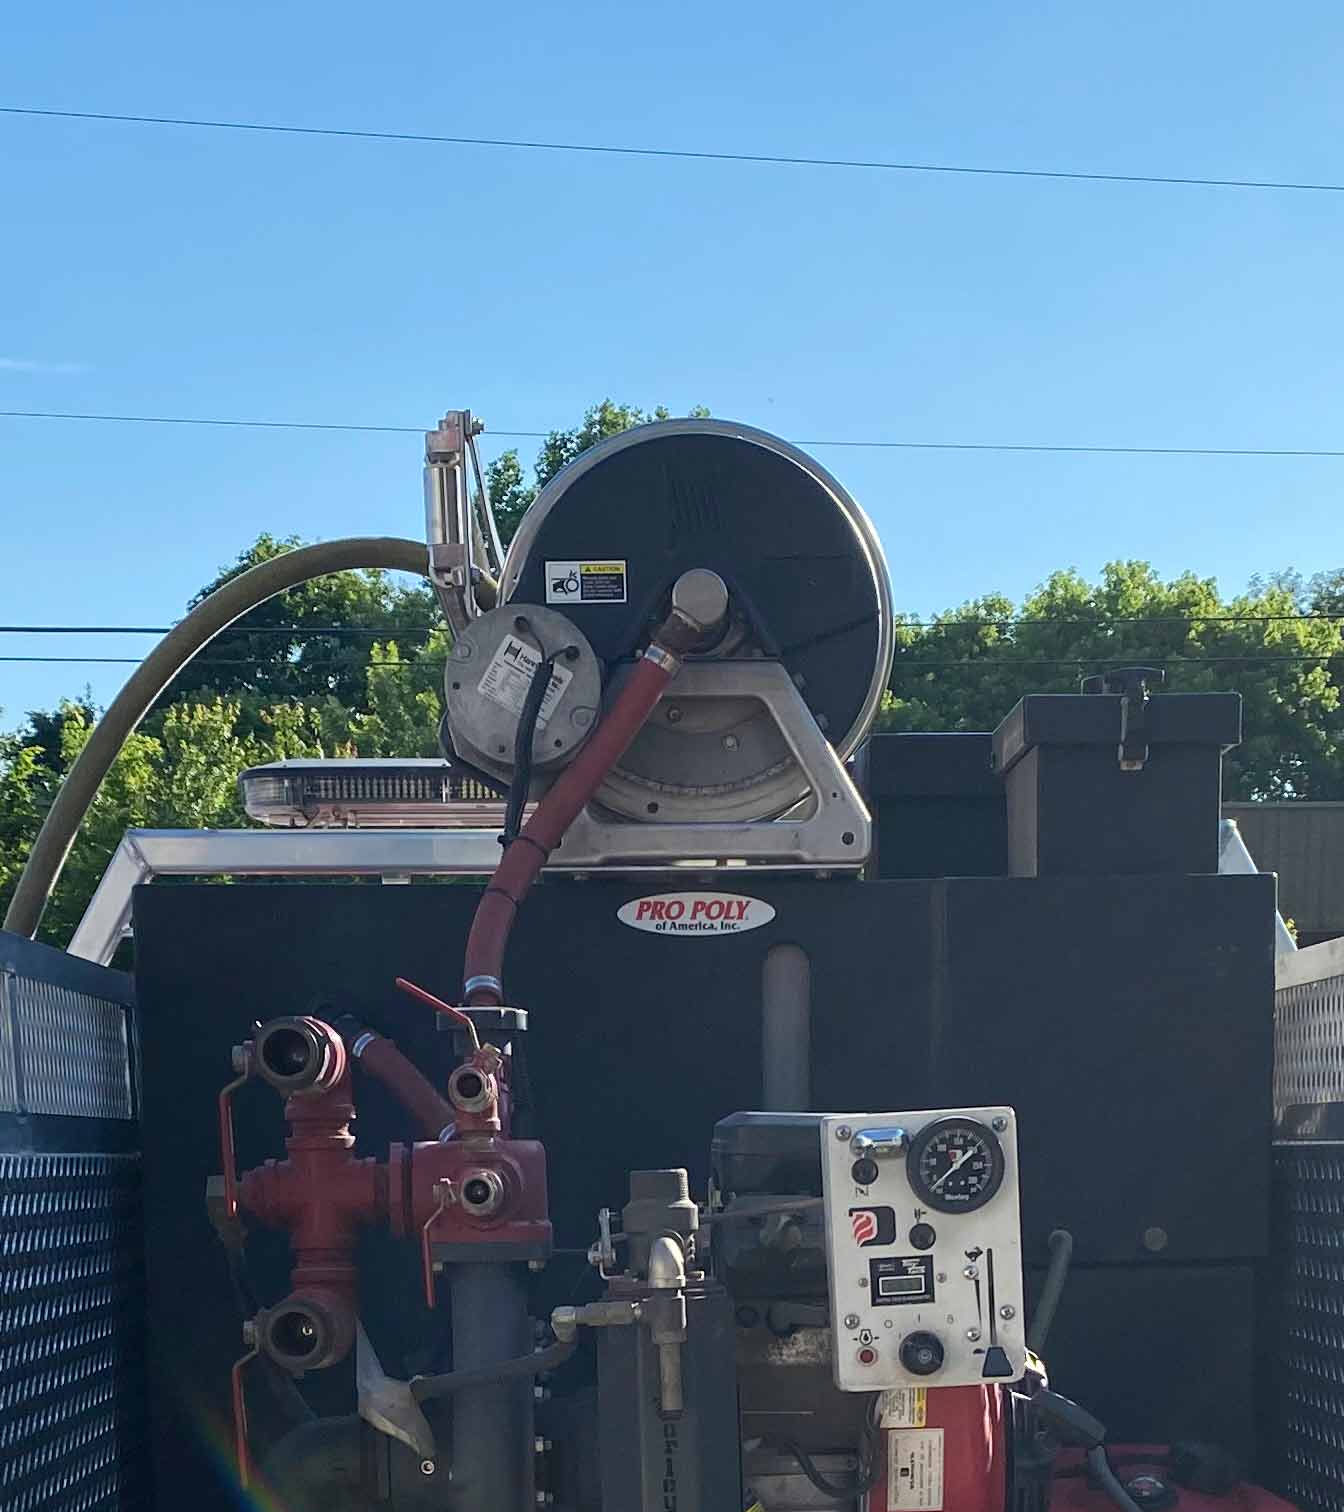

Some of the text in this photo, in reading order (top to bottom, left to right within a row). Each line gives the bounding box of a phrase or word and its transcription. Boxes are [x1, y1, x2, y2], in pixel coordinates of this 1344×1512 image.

[636, 900, 752, 921] PRO POLY
[655, 921, 741, 931] of America, Inc.
